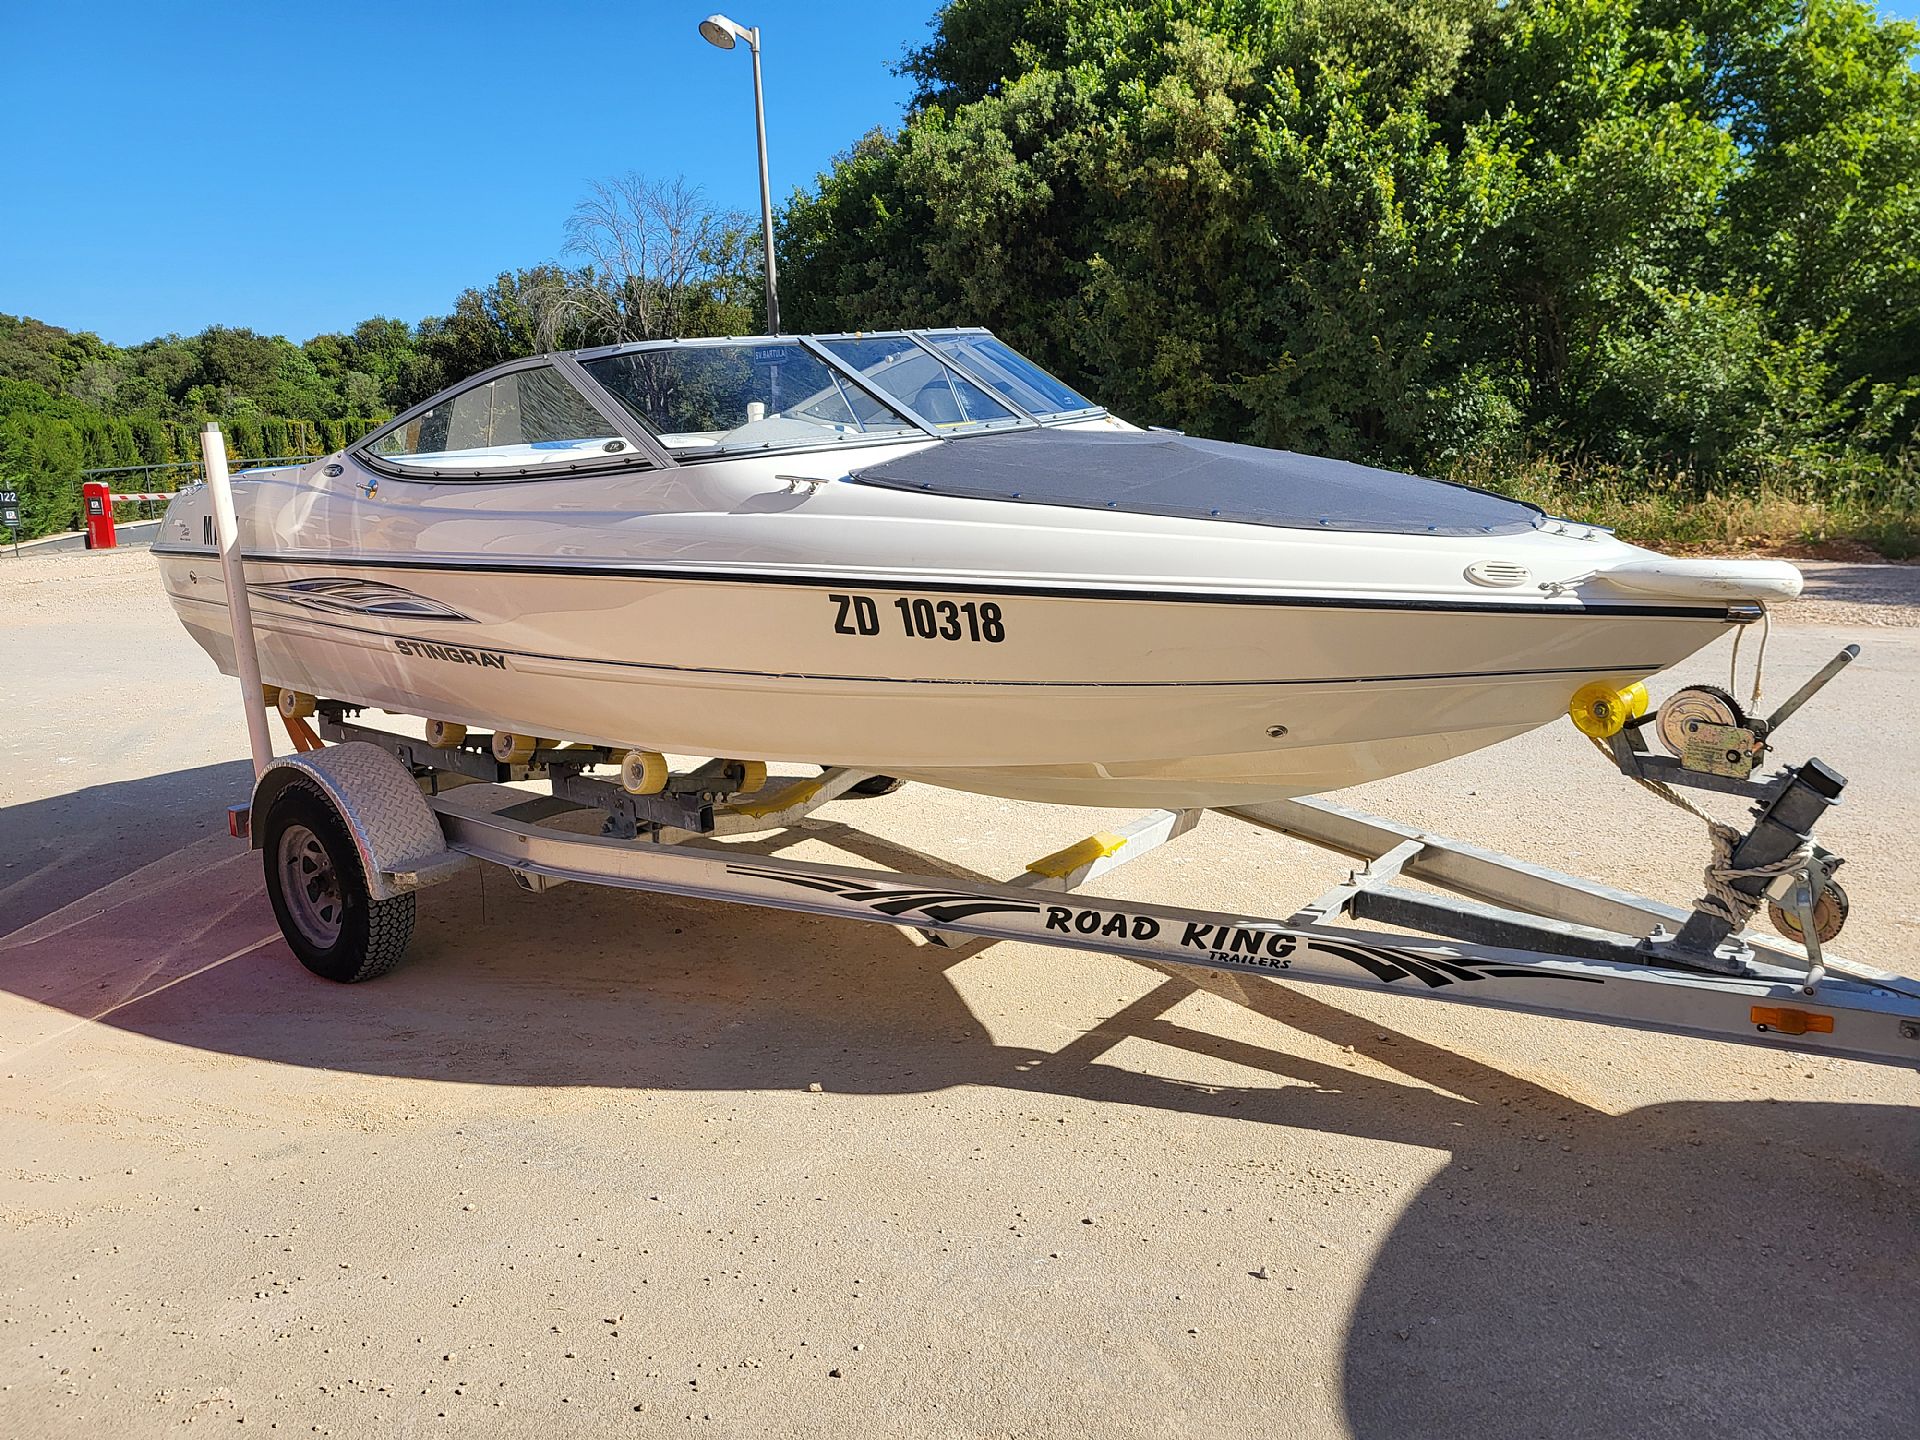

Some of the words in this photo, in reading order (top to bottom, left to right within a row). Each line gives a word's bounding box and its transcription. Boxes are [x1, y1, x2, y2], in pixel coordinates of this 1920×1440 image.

[828, 594, 880, 636] ZD
[894, 597, 1006, 643] 10318
[394, 639, 507, 670] STINGRAY
[1045, 906, 1161, 941] ROAD
[1180, 922, 1297, 957] KING
[1208, 950, 1292, 969] TRAILERS
